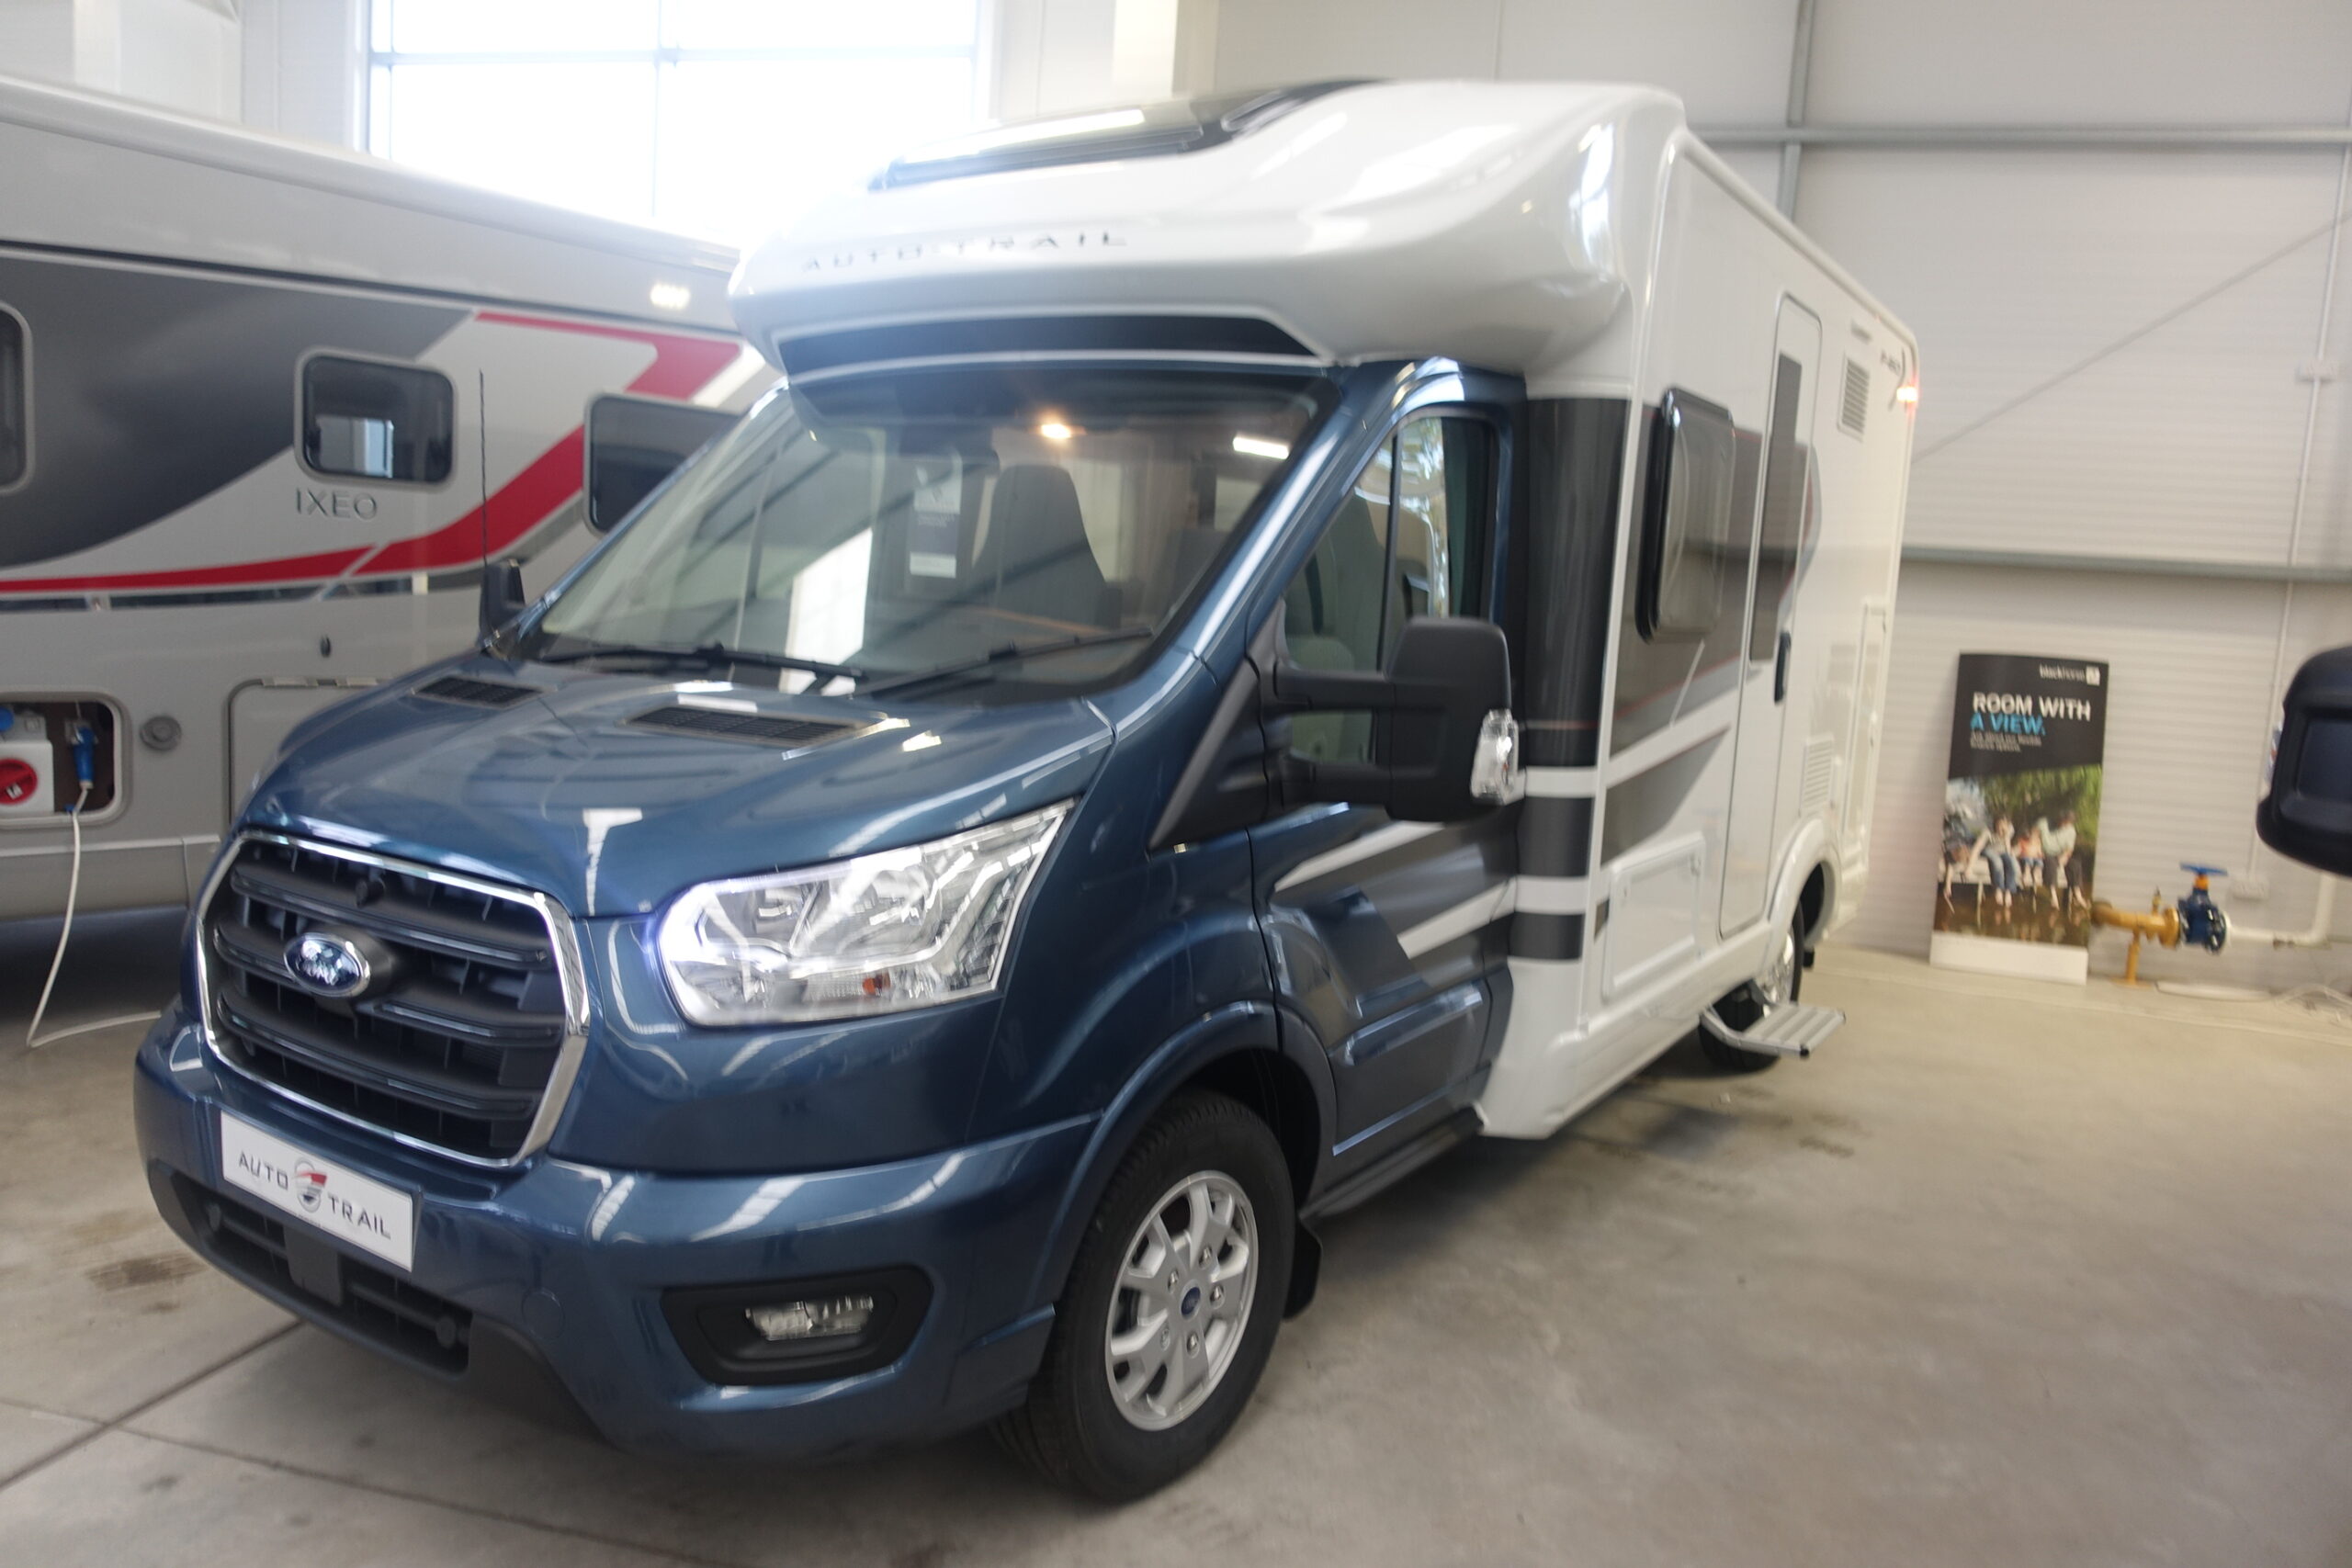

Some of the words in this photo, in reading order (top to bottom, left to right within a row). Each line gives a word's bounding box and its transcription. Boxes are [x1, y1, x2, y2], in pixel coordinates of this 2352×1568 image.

[296, 487, 378, 520] IXEO
[1971, 711, 1984, 731] A
[1973, 692, 2033, 716] ROOM
[2039, 695, 2091, 722] WITH
[239, 1150, 288, 1191] AUTO
[327, 1193, 391, 1240] TRAIL
